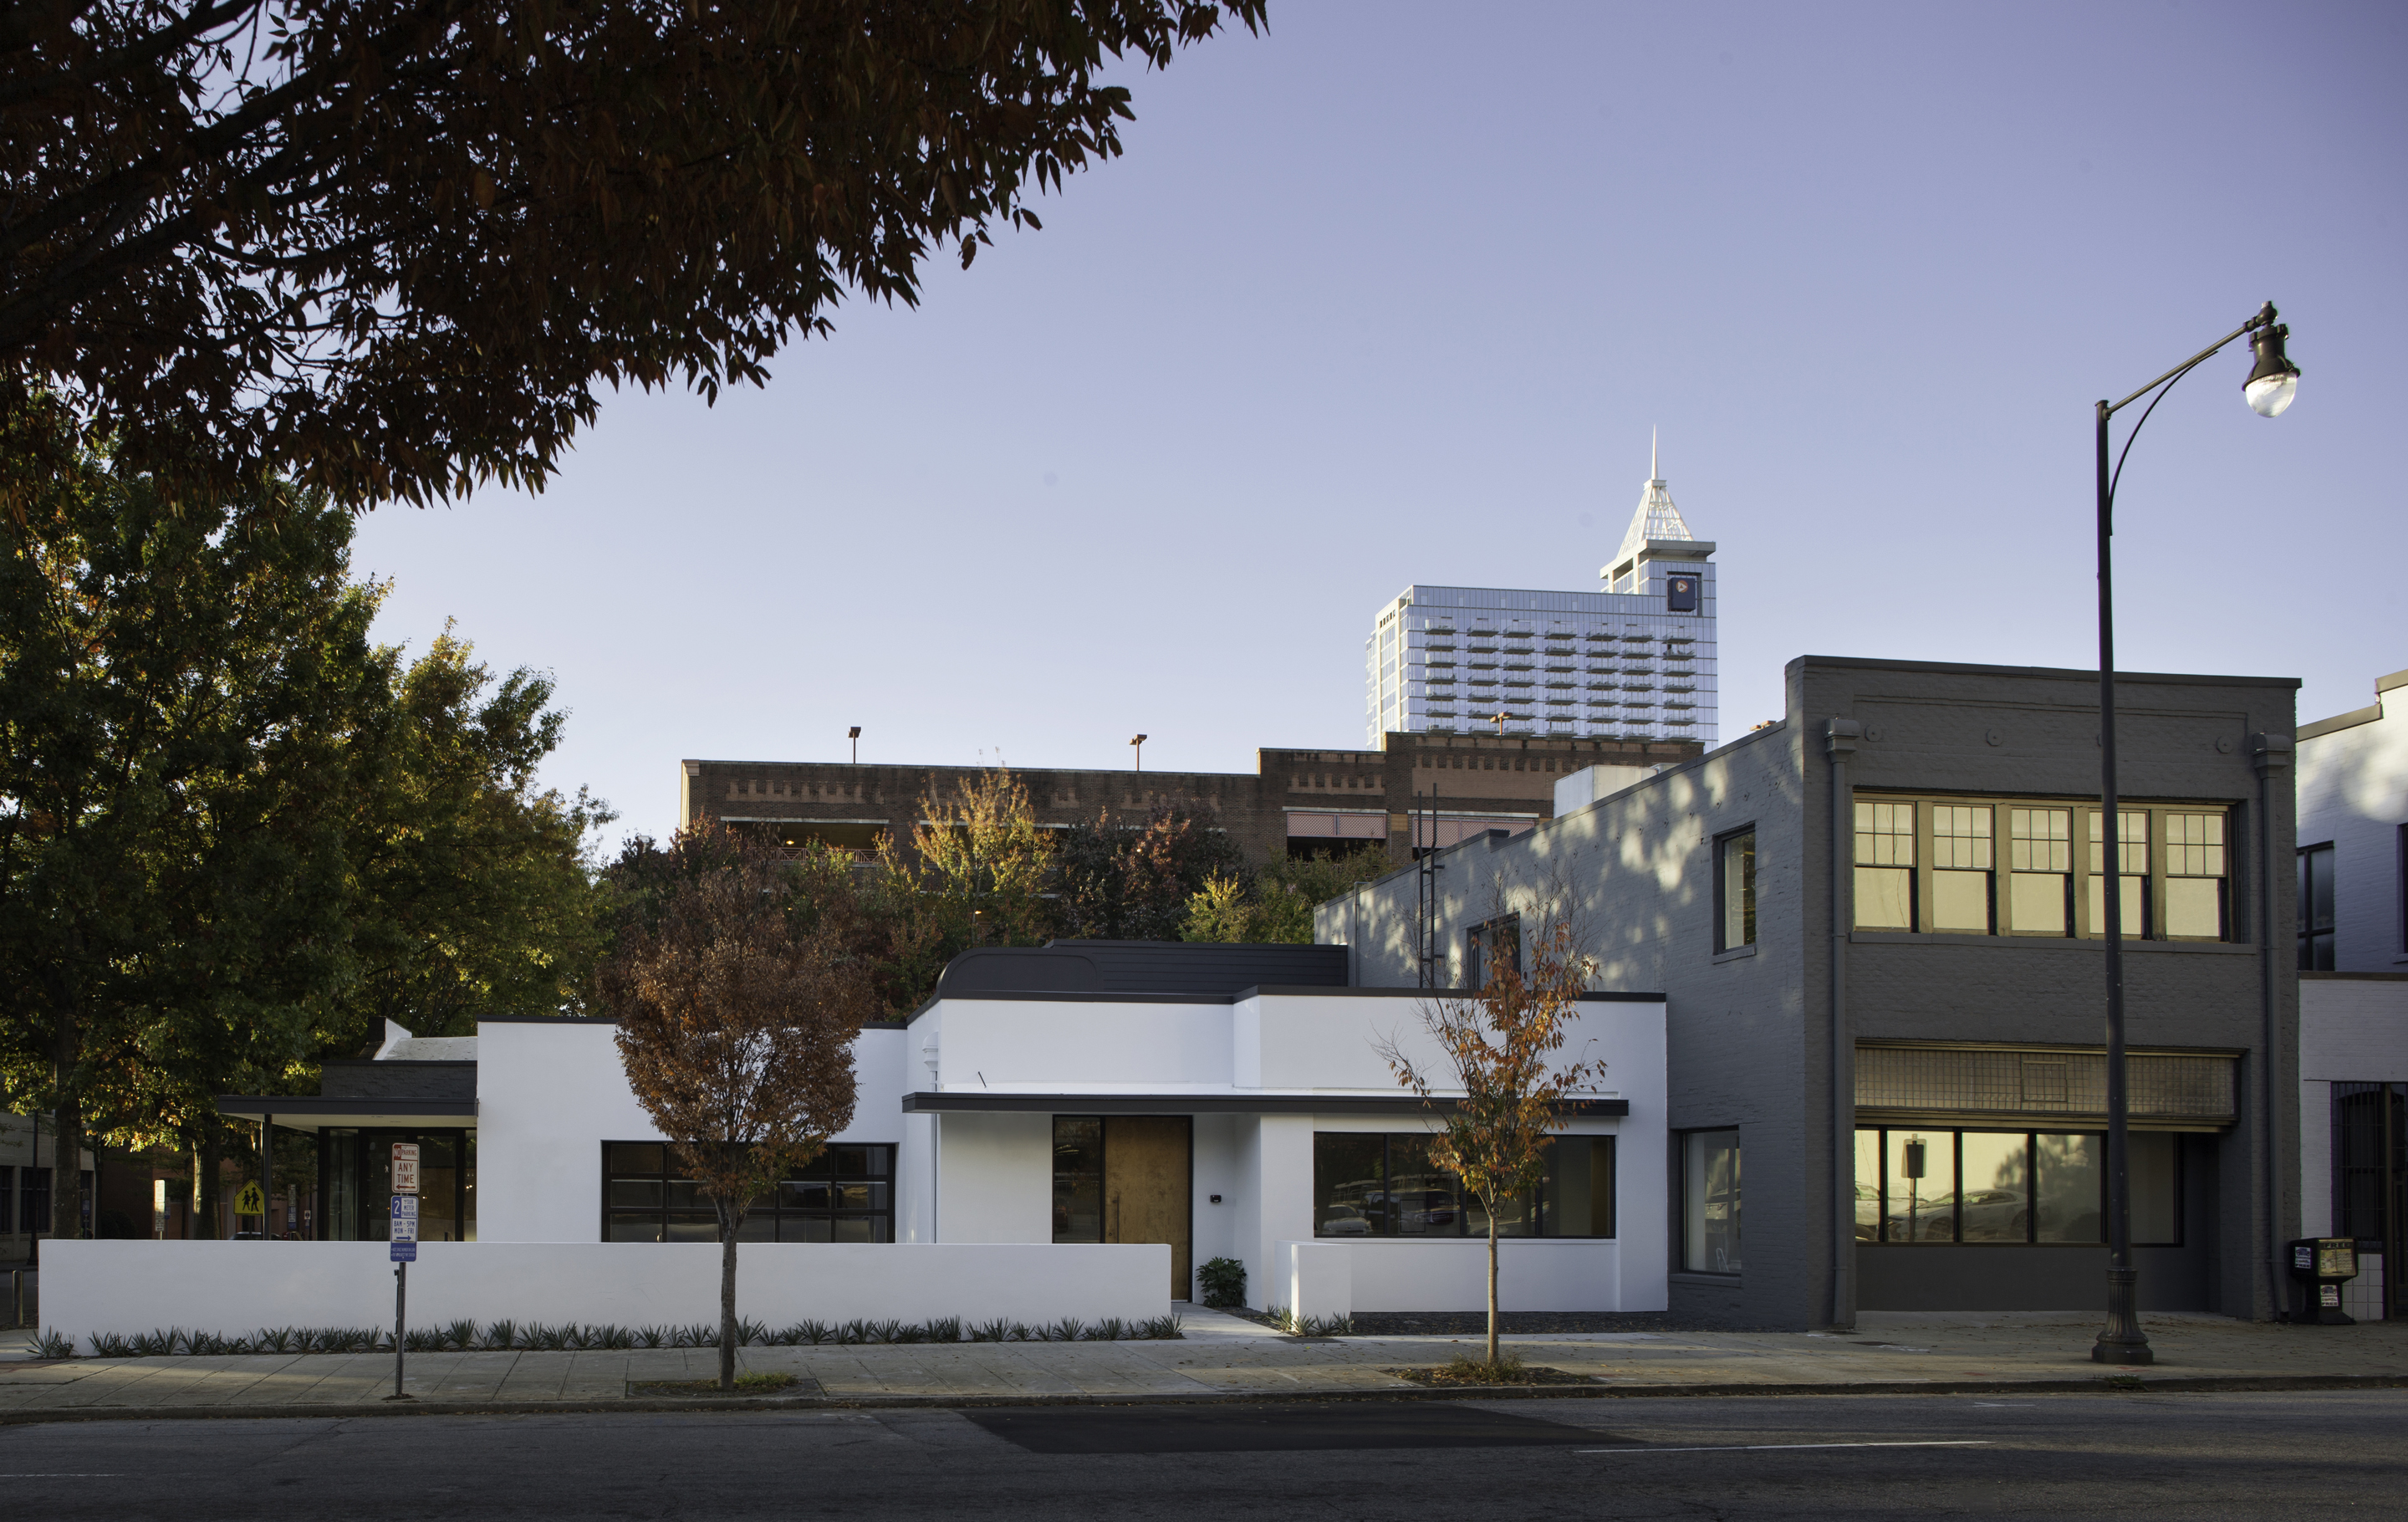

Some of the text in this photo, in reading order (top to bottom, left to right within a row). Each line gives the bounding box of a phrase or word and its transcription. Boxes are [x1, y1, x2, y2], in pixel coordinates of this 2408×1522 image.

[394, 1147, 401, 1157] NO
[398, 1162, 413, 1172] ANY
[397, 1173, 414, 1183] TIME
[394, 1199, 400, 1215] 2
